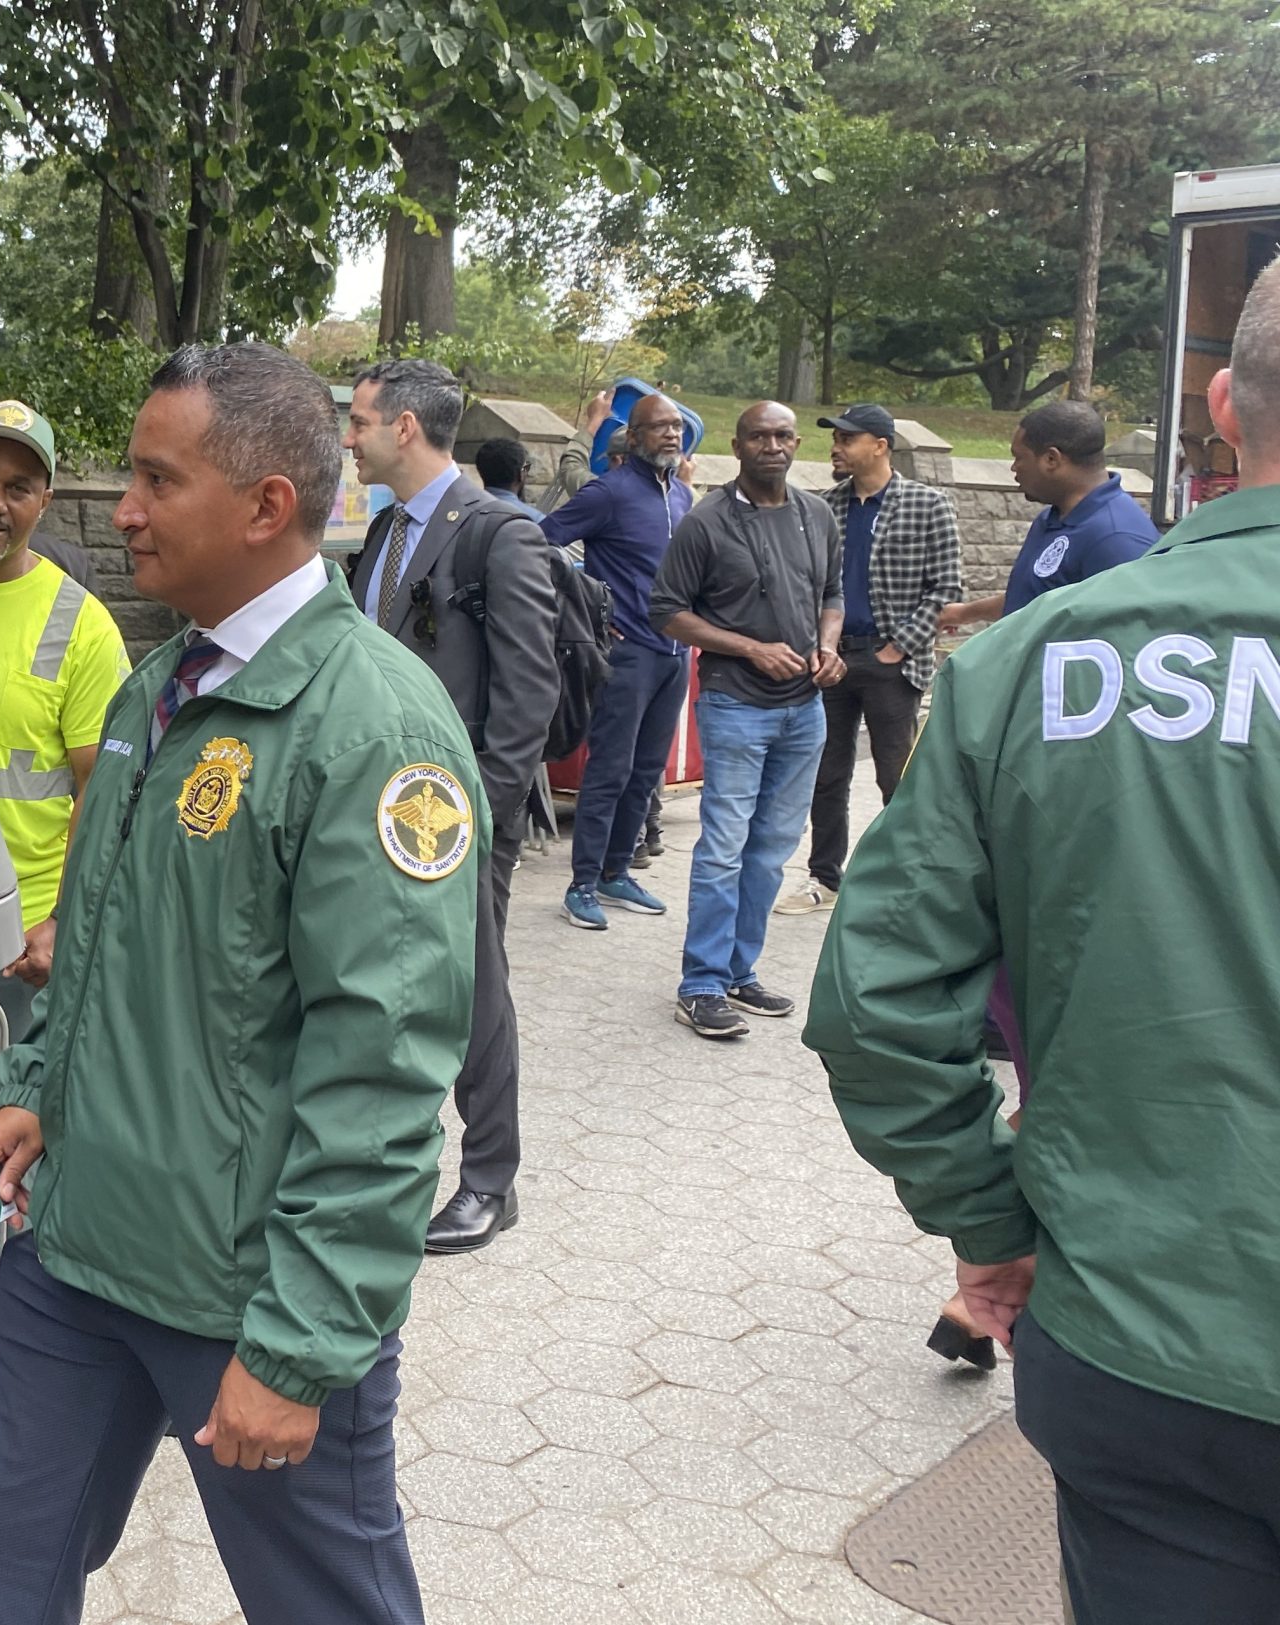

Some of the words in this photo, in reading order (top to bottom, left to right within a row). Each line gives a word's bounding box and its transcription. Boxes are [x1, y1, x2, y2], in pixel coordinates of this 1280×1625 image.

[399, 770, 417, 785] NEW
[418, 768, 439, 780] YORK
[439, 774, 455, 790] CITY
[385, 826, 421, 870] DEPARTMENT
[423, 864, 432, 872] OF
[435, 835, 468, 872] SANITATION
